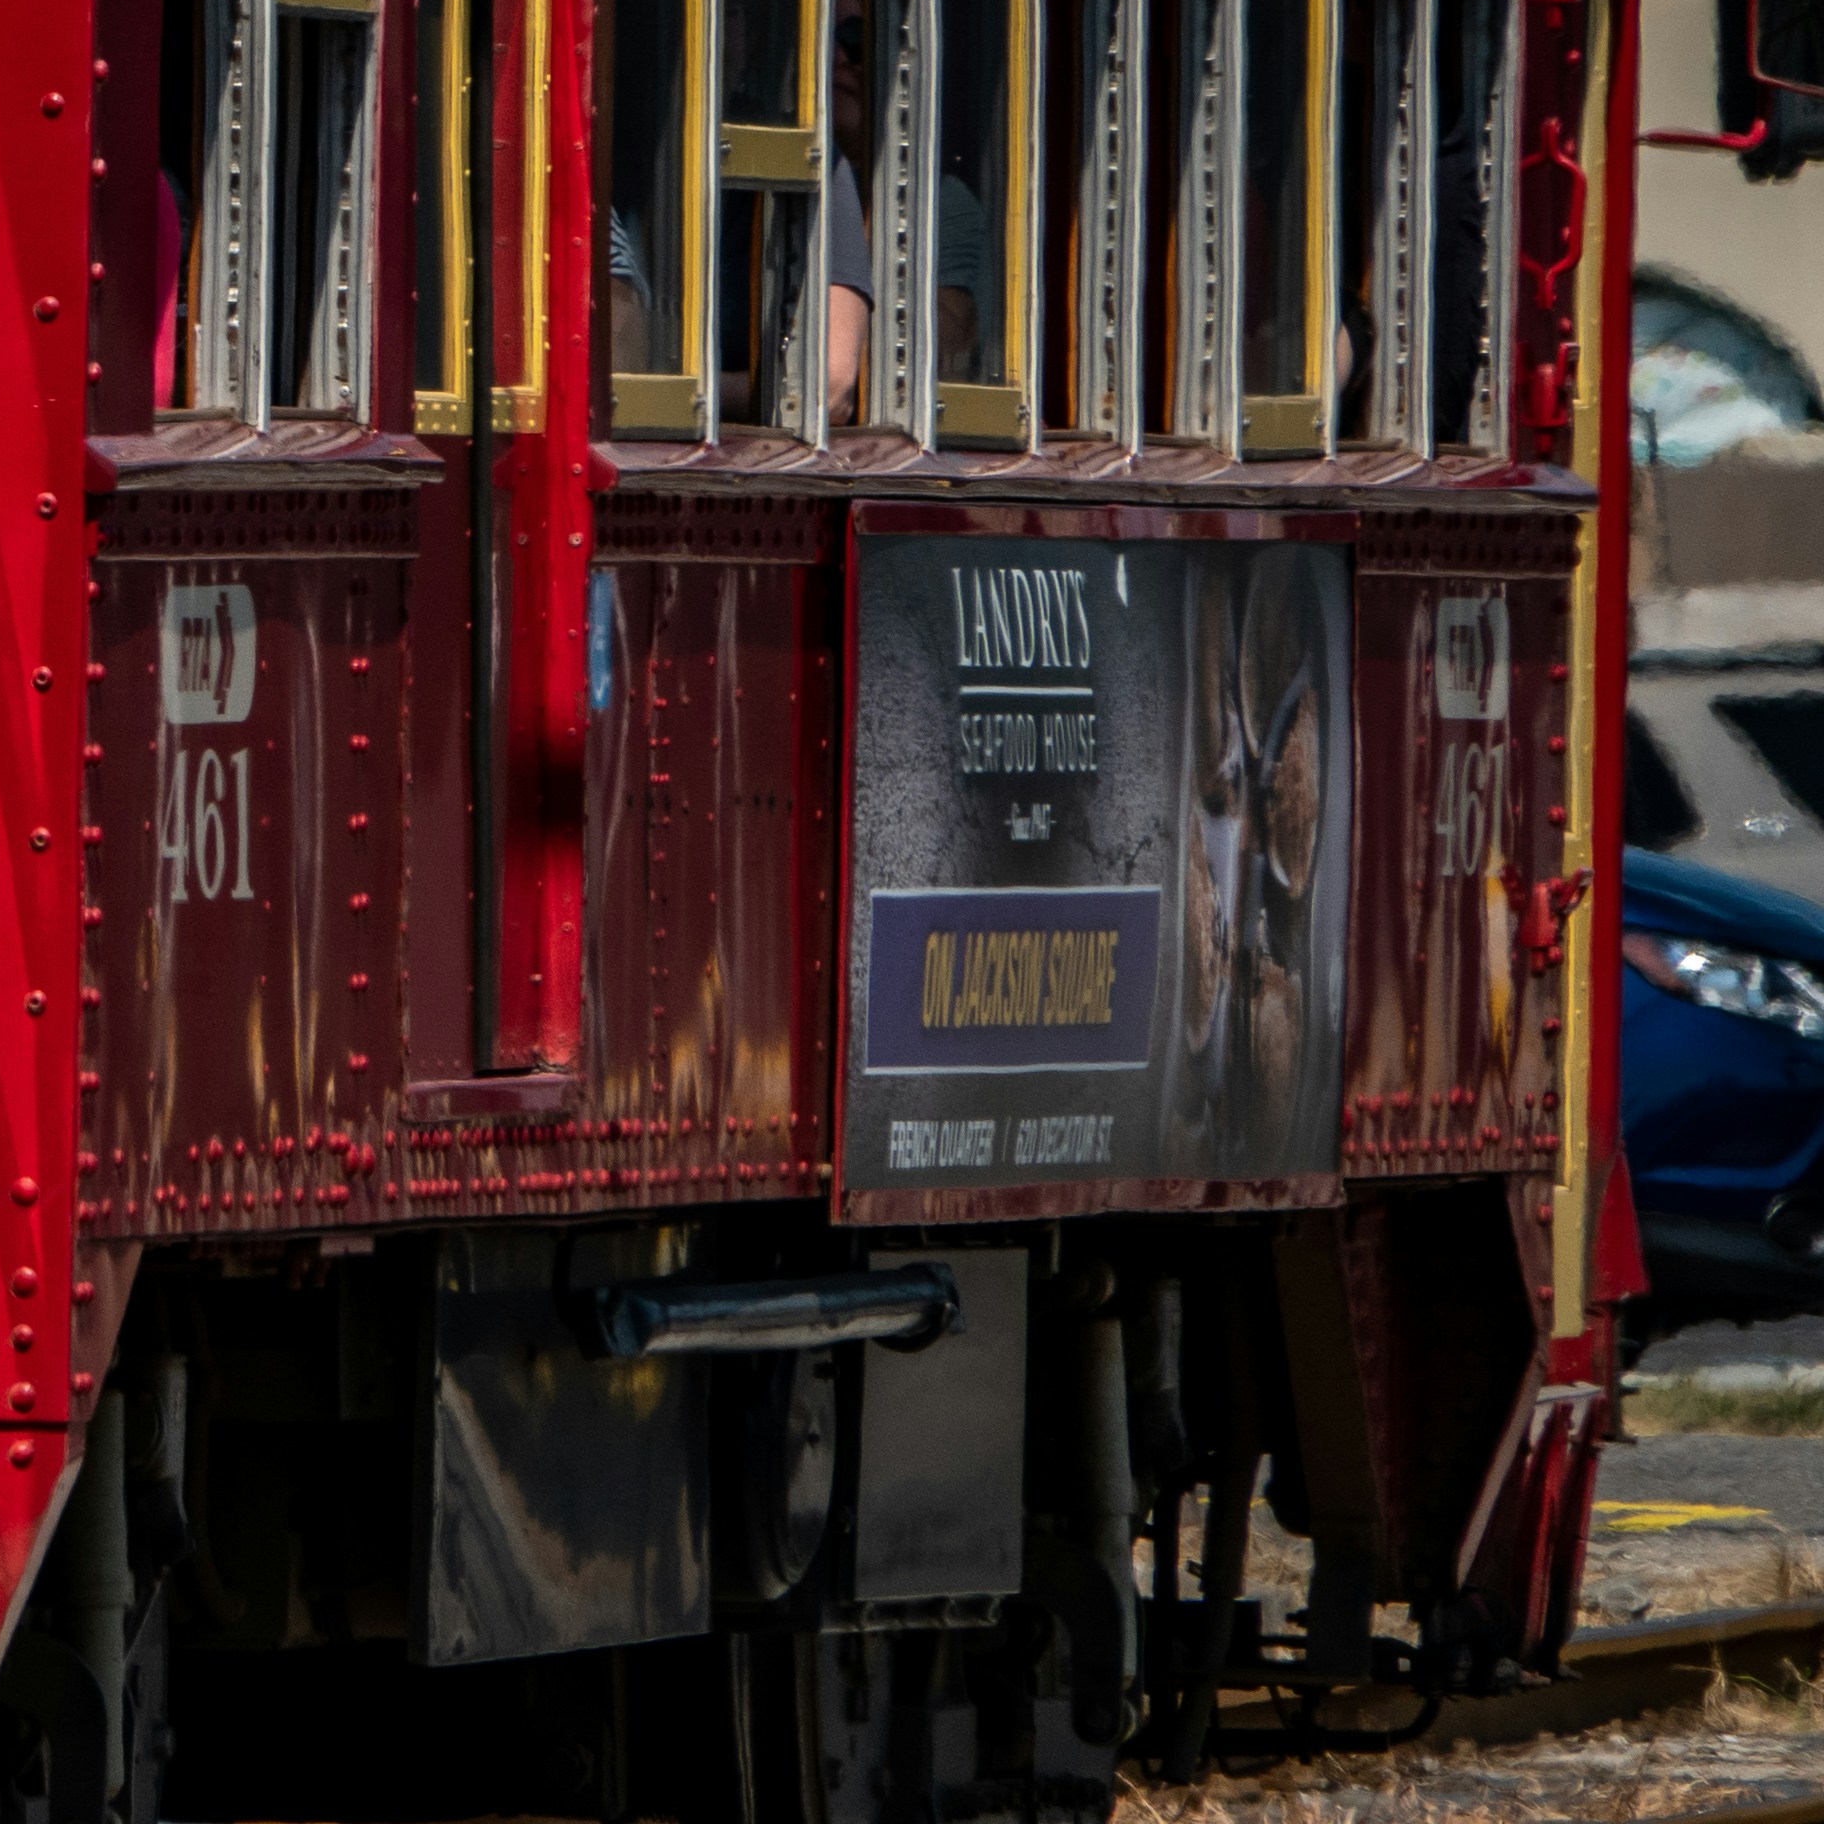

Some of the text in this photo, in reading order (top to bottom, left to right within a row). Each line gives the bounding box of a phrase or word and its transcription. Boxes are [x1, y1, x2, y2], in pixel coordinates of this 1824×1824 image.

[951, 567, 1091, 668] LANDRY'S
[960, 713, 1097, 773] SEAFOOD HOUSE
[160, 748, 253, 904] 461
[1435, 742, 1506, 878] 461
[922, 930, 1119, 1028] ON JACKSON SQUARE
[890, 1120, 938, 1168] FRENCH
[939, 1119, 996, 1167] QUARTER
